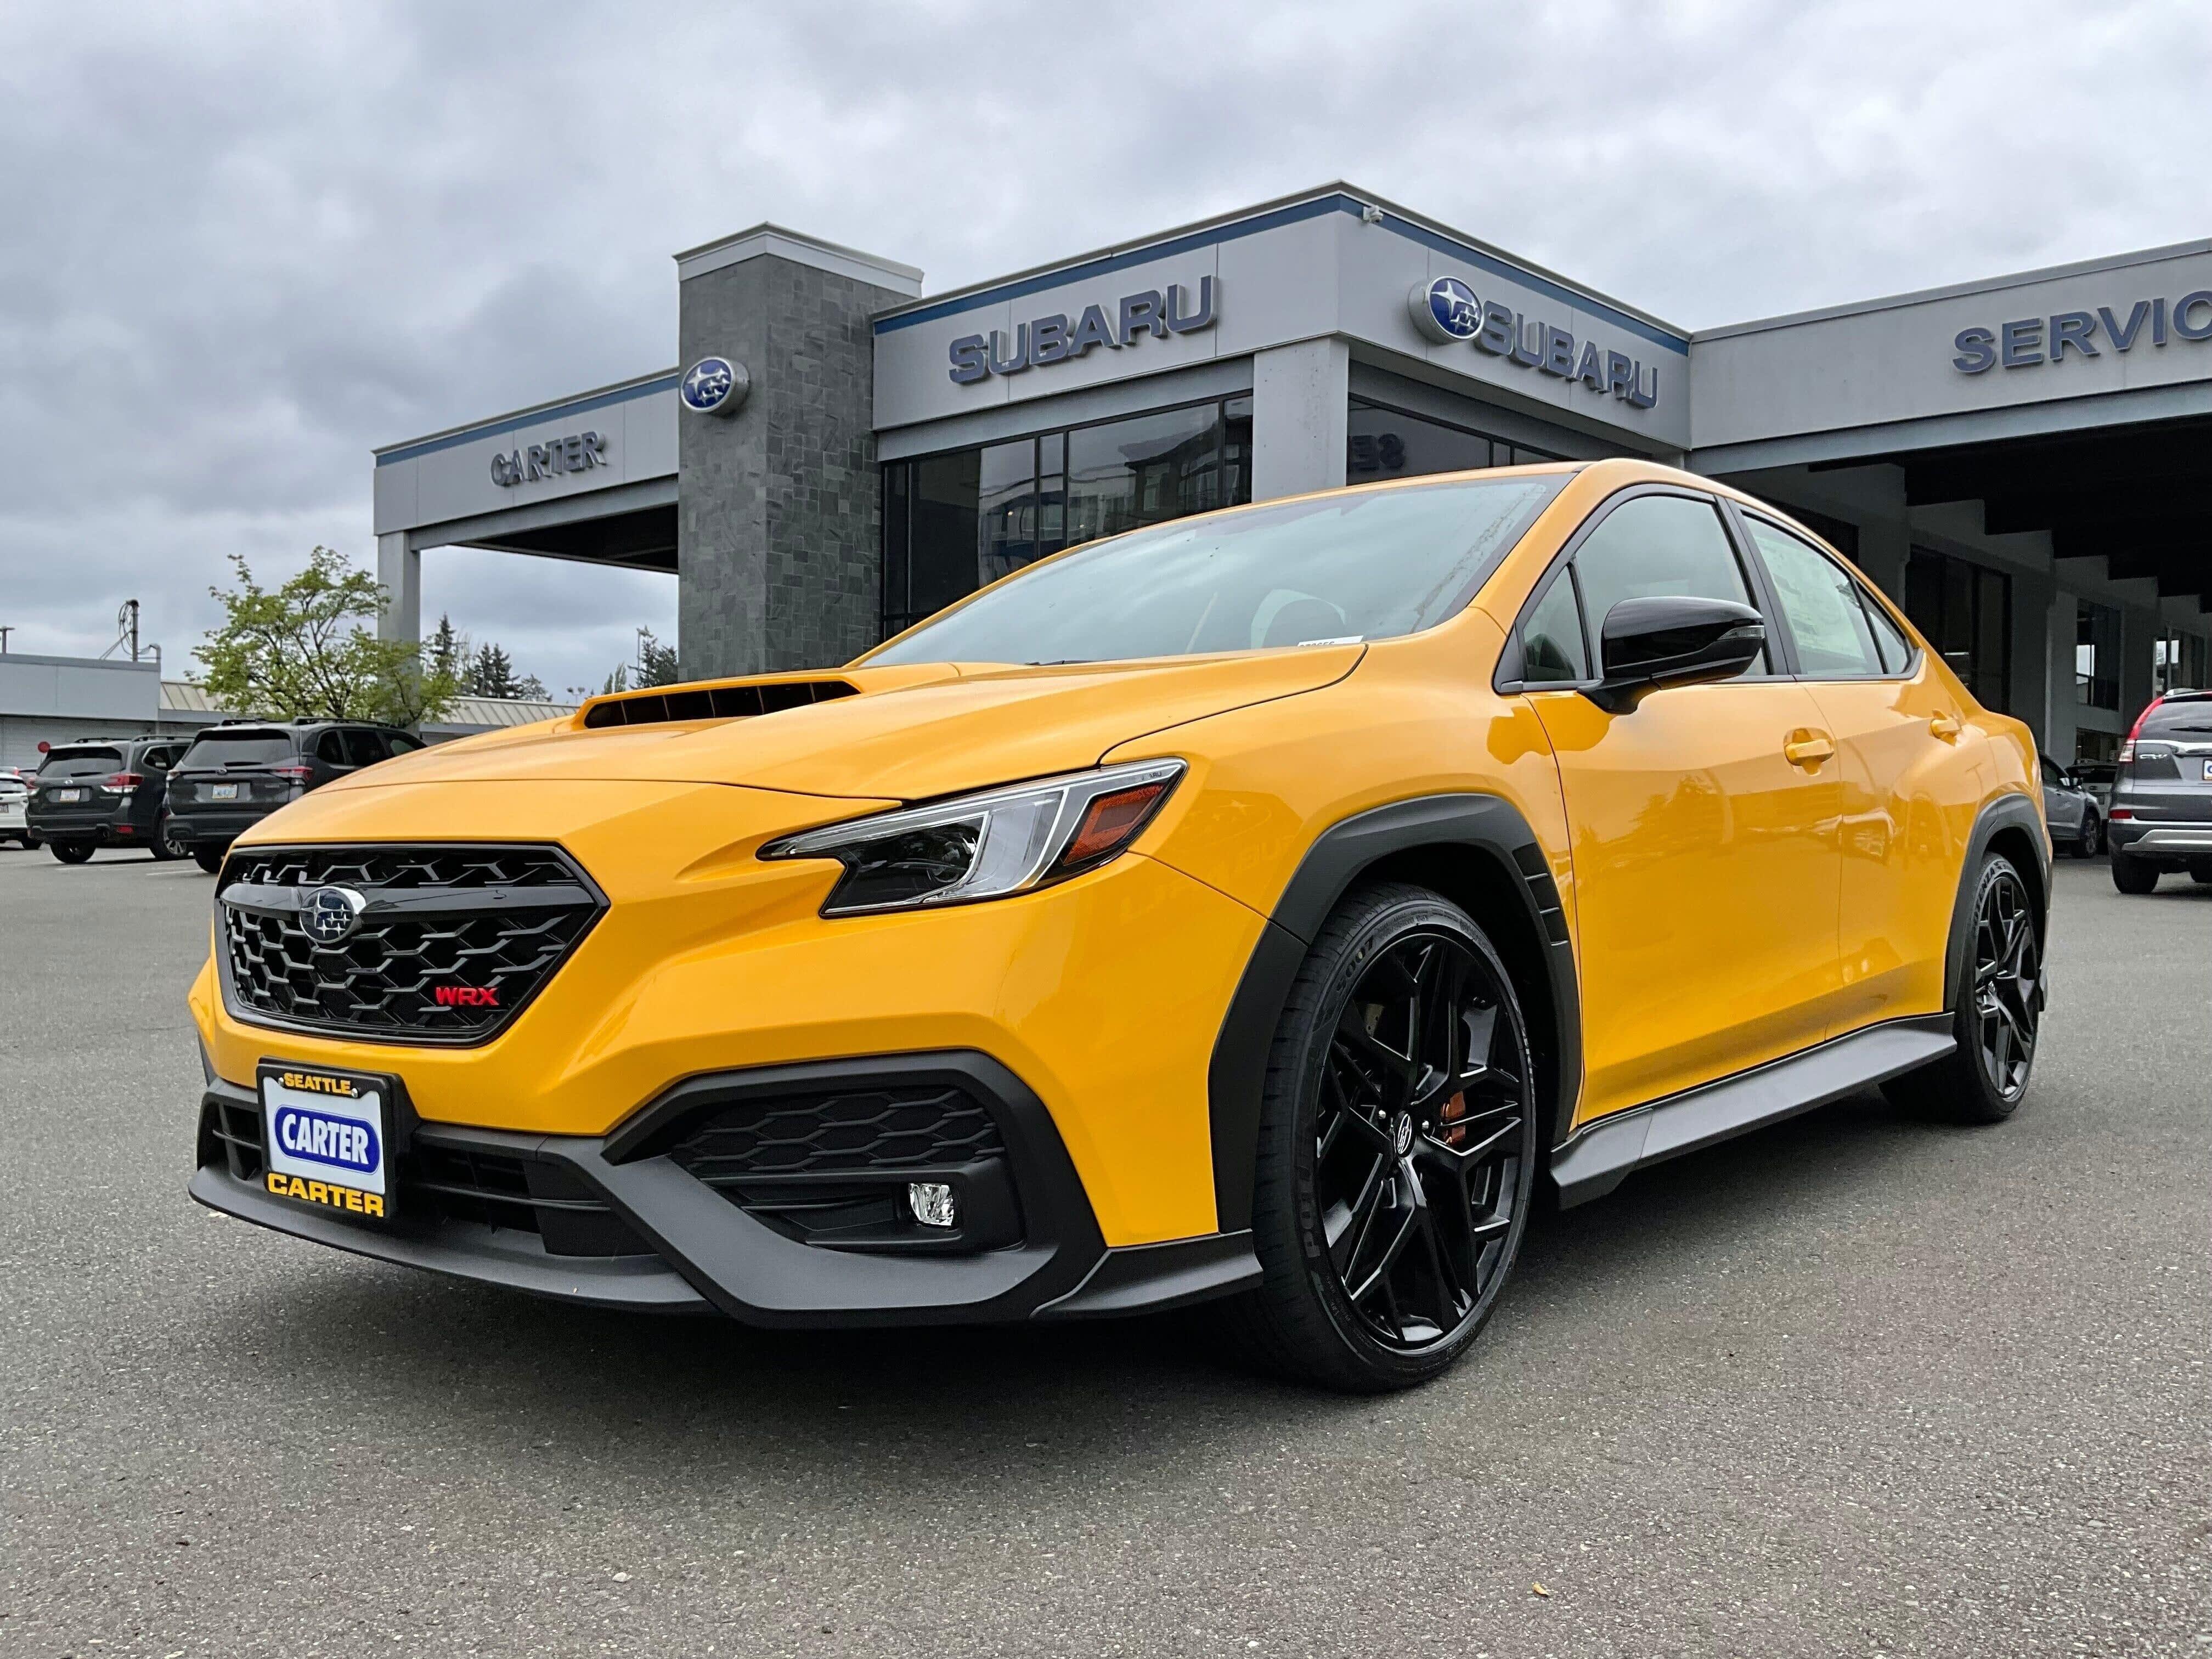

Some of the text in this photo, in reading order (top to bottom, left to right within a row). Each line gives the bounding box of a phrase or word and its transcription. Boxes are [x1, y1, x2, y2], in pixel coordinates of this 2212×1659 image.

[949, 275, 1218, 385] SUBARU
[1480, 300, 1658, 408] SUBARU
[1953, 290, 2212, 375] SERVIC
[491, 431, 606, 486] CARTER
[436, 986, 499, 1006] WRX
[283, 1072, 352, 1094] SEATTLE
[282, 1113, 369, 1165] CARTER
[268, 1172, 384, 1217] CARTER
